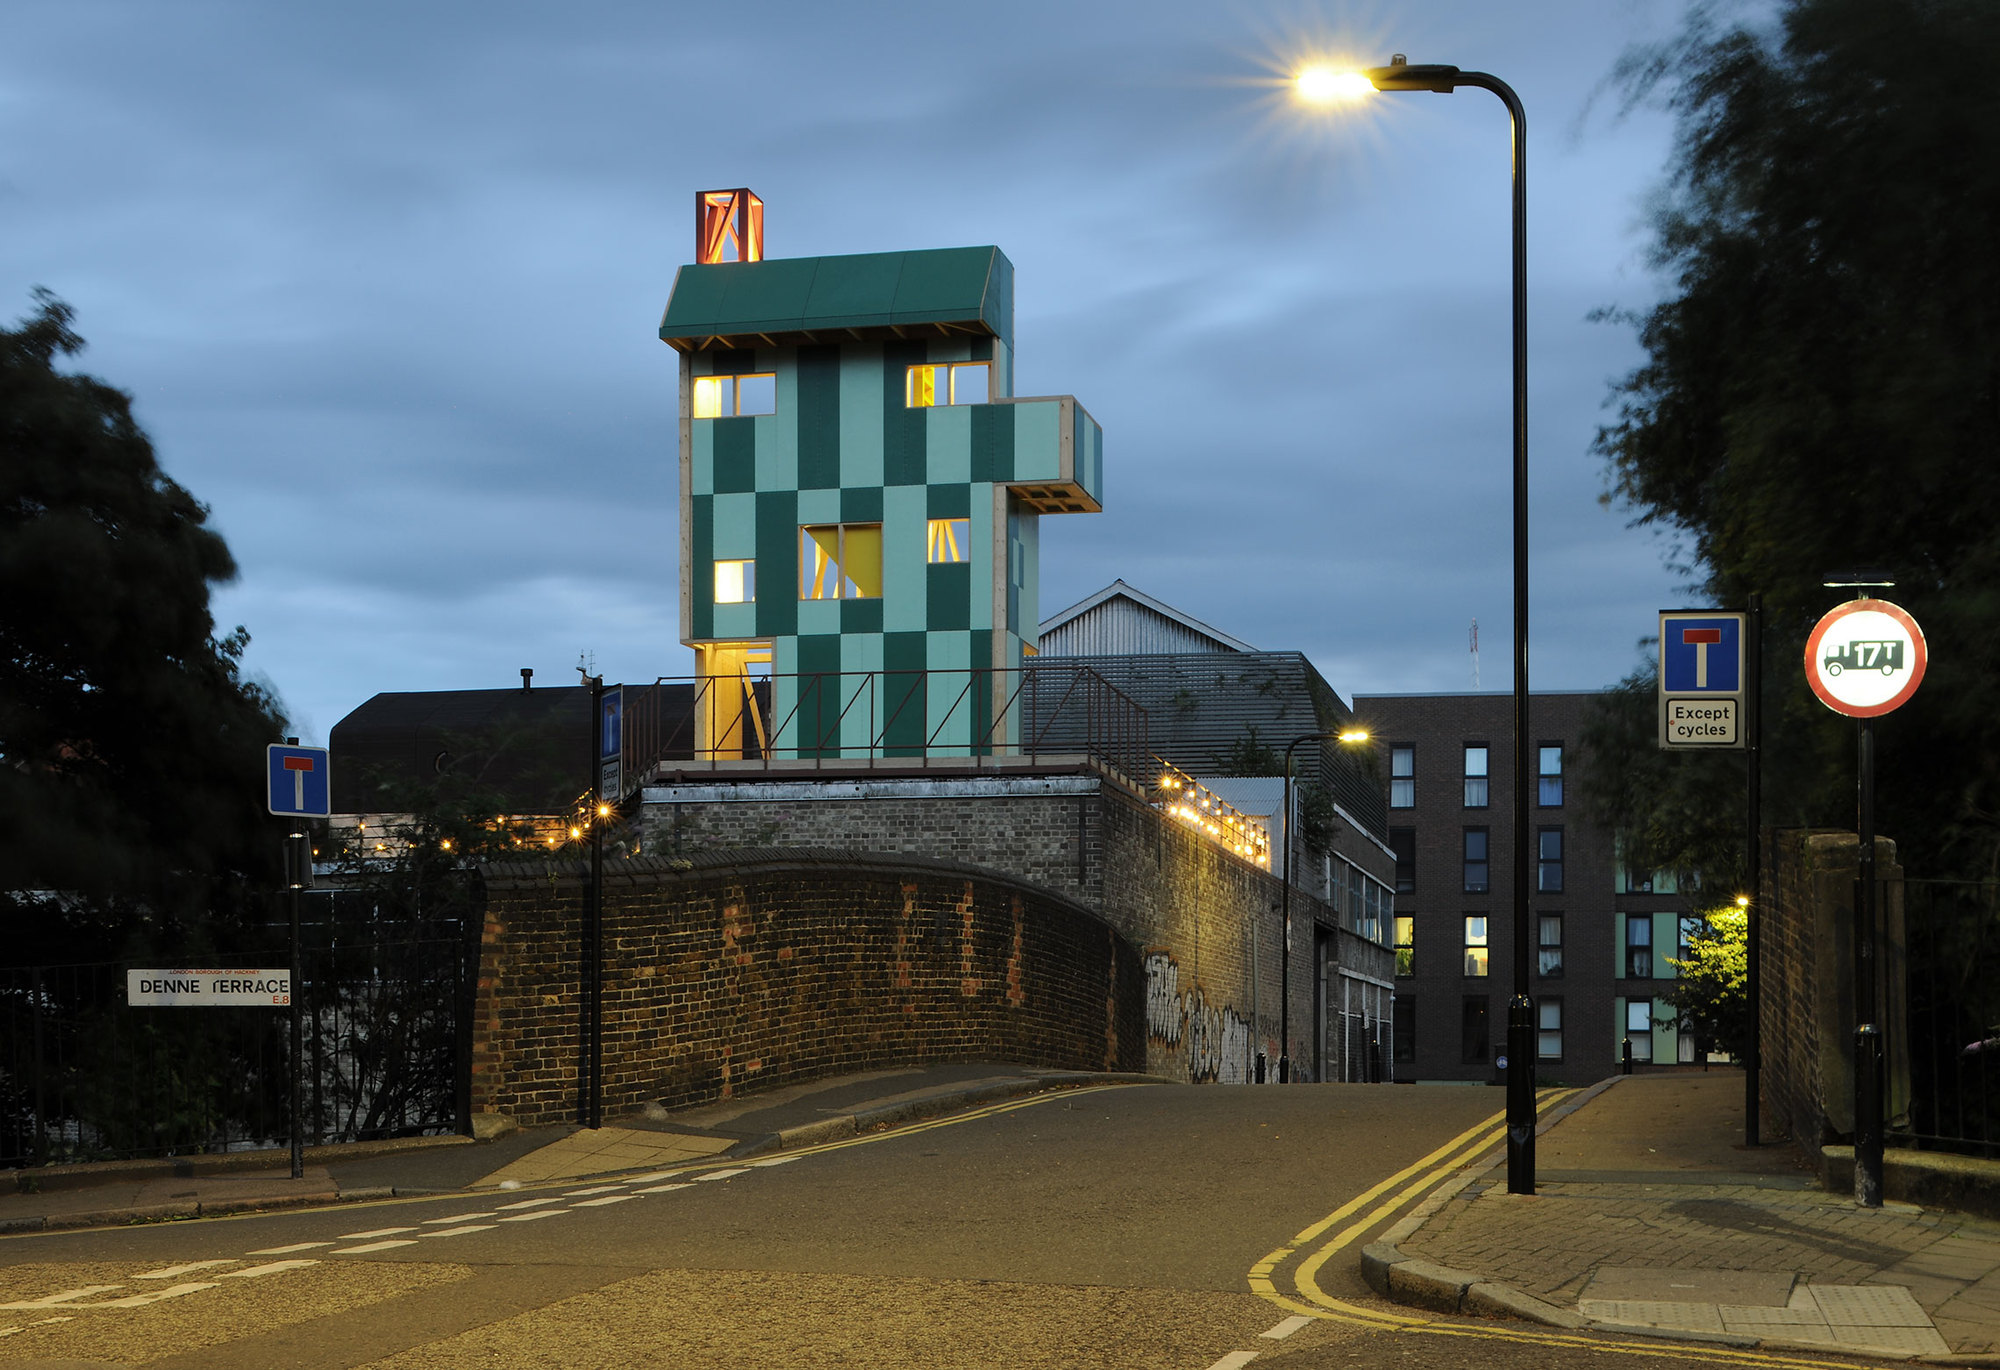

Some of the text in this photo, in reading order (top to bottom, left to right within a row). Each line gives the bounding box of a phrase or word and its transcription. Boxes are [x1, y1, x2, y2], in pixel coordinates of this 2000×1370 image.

[1854, 642, 1897, 667] 17T
[1675, 706, 1730, 721] Except
[1677, 722, 1727, 738] cycles
[140, 979, 200, 994] DENNE
[272, 995, 289, 1004] E.8
